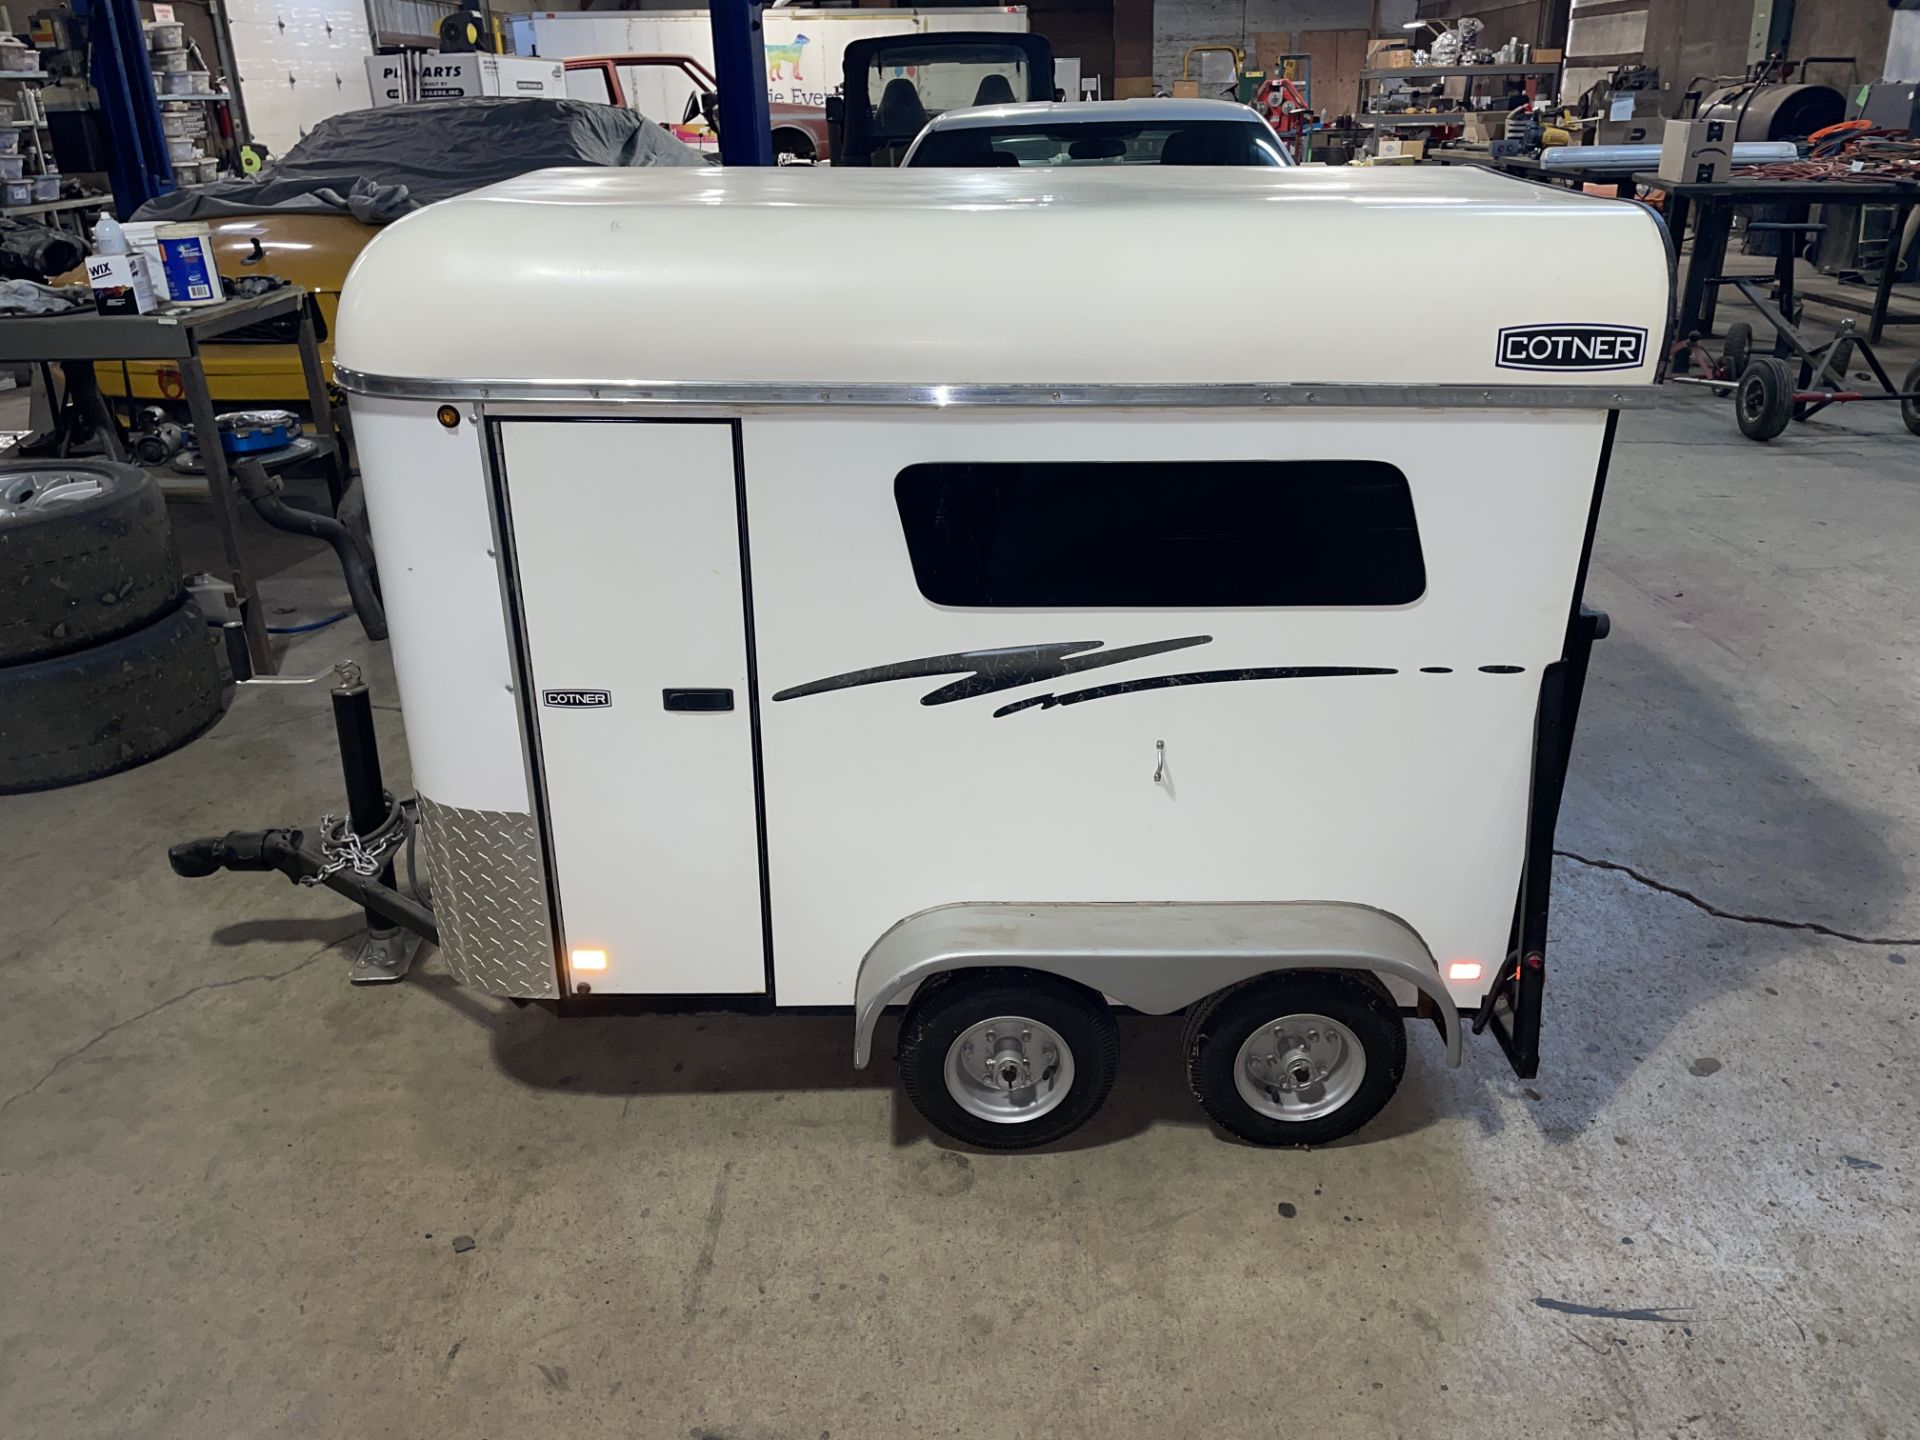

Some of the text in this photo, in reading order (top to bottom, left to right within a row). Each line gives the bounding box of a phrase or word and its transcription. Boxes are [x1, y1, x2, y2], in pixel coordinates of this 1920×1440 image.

[421, 66, 462, 78] ARTS
[89, 262, 112, 277] WIX
[1506, 335, 1637, 360] COTNER
[548, 693, 606, 704] COTNER
